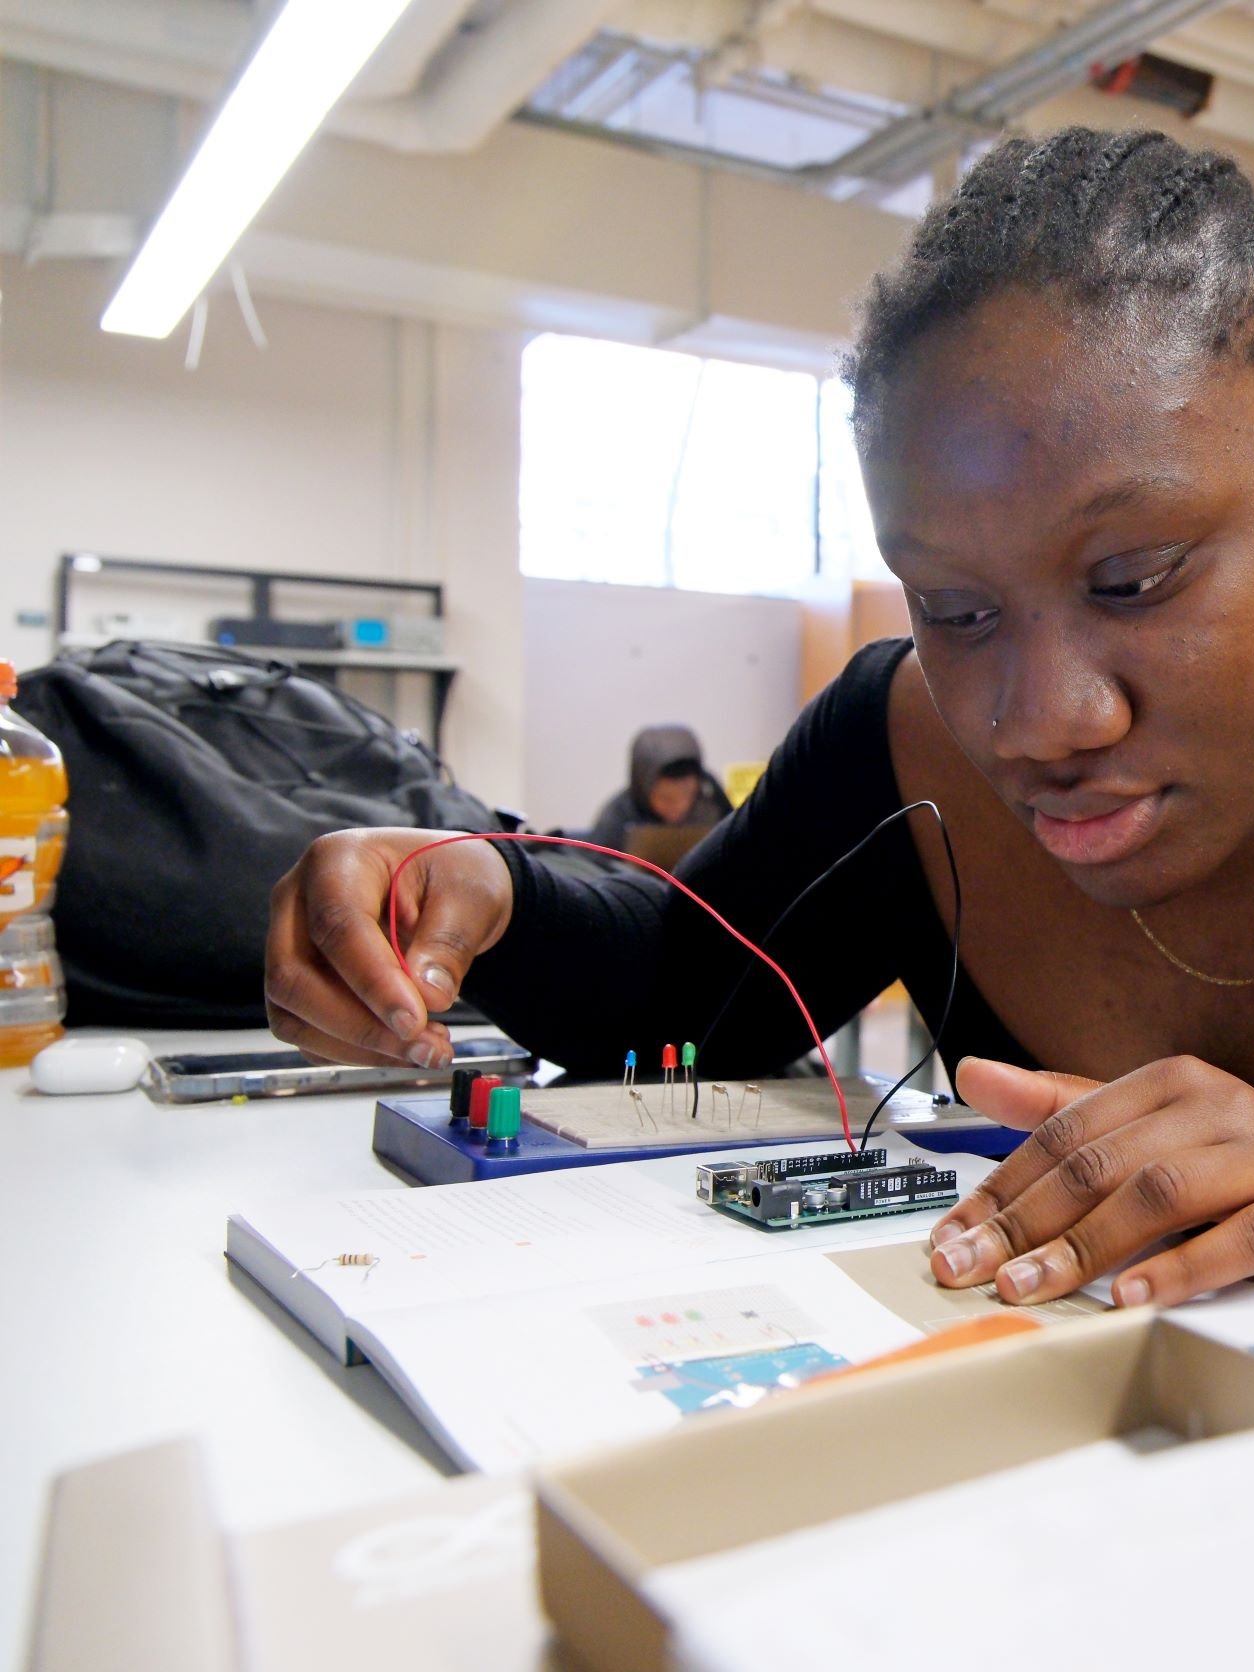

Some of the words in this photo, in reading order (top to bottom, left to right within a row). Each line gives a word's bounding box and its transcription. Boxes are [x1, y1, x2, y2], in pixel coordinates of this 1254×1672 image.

[789, 1160, 794, 1168] 13
[795, 1160, 800, 1168] 12
[916, 1176, 921, 1185] A0
[923, 1175, 929, 1184] A1
[930, 1174, 935, 1183] A2
[937, 1173, 942, 1182] A3
[943, 1172, 949, 1182] A4
[950, 1172, 956, 1181] A5
